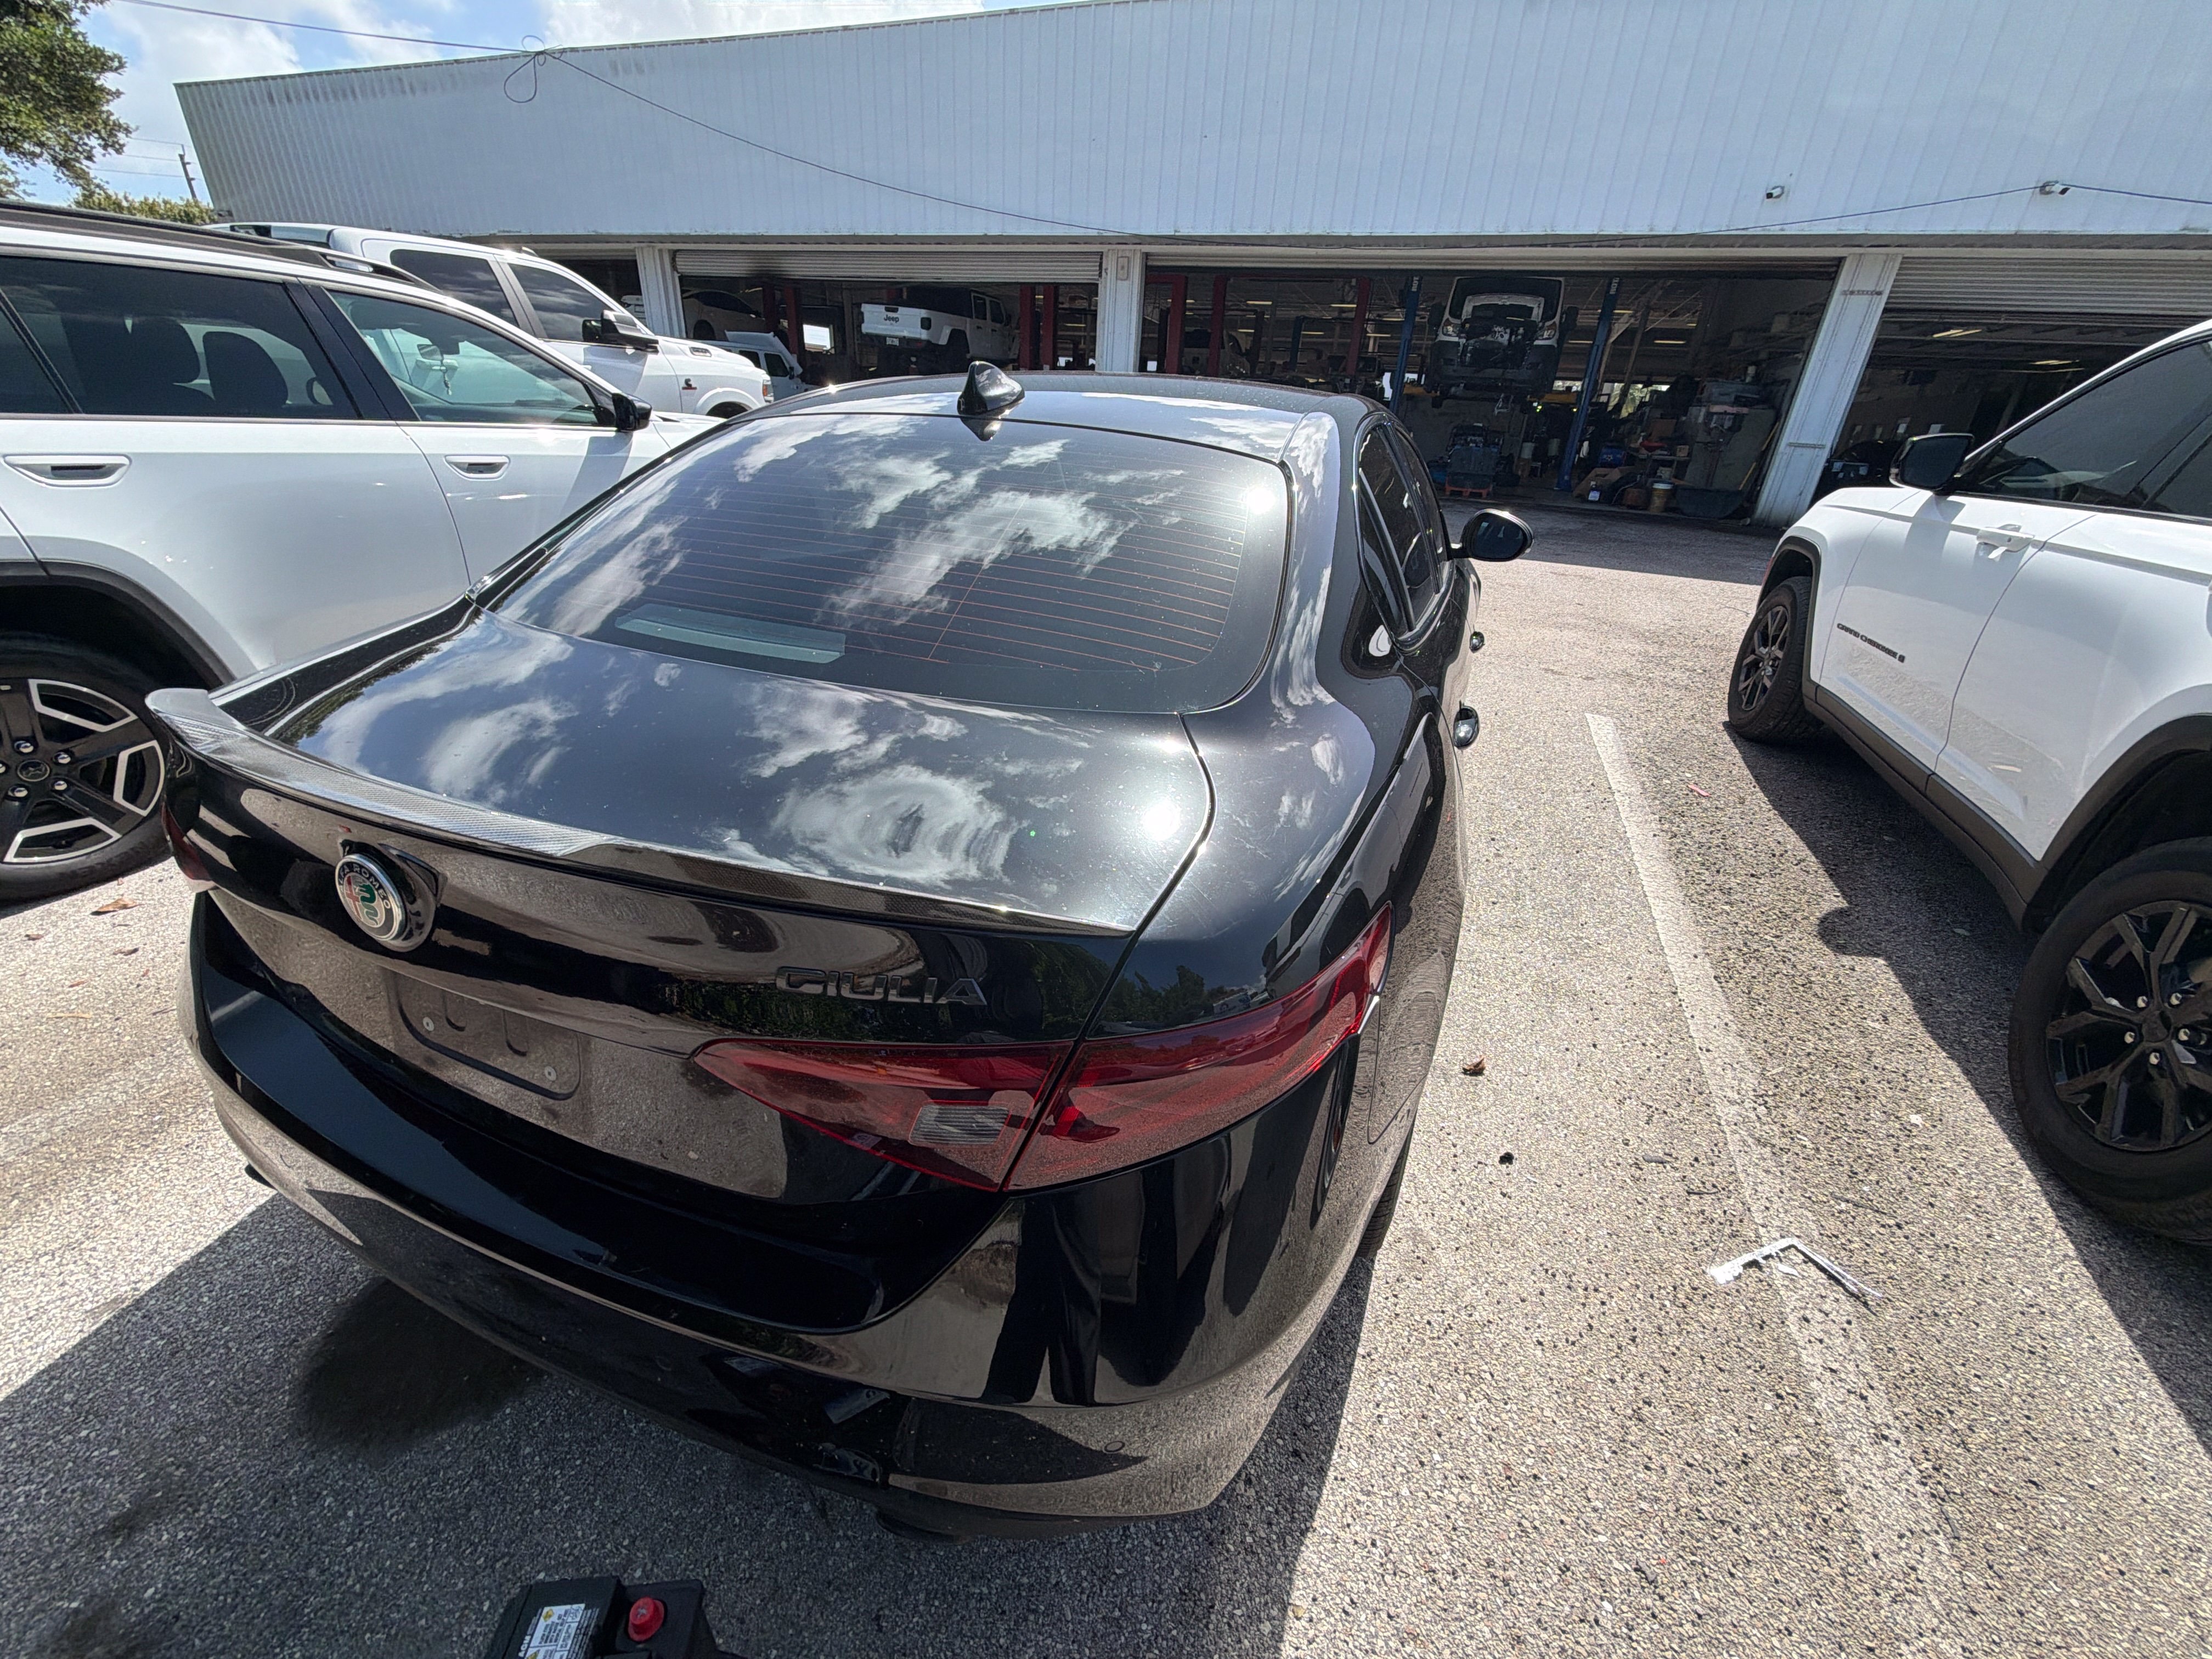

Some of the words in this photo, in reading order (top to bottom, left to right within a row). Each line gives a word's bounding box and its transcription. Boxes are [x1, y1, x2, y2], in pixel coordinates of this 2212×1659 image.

[883, 314, 899, 323] Jeep
[338, 865, 350, 892] ALFA
[353, 864, 391, 909] ROMEO
[775, 966, 988, 1006] GIULIA
